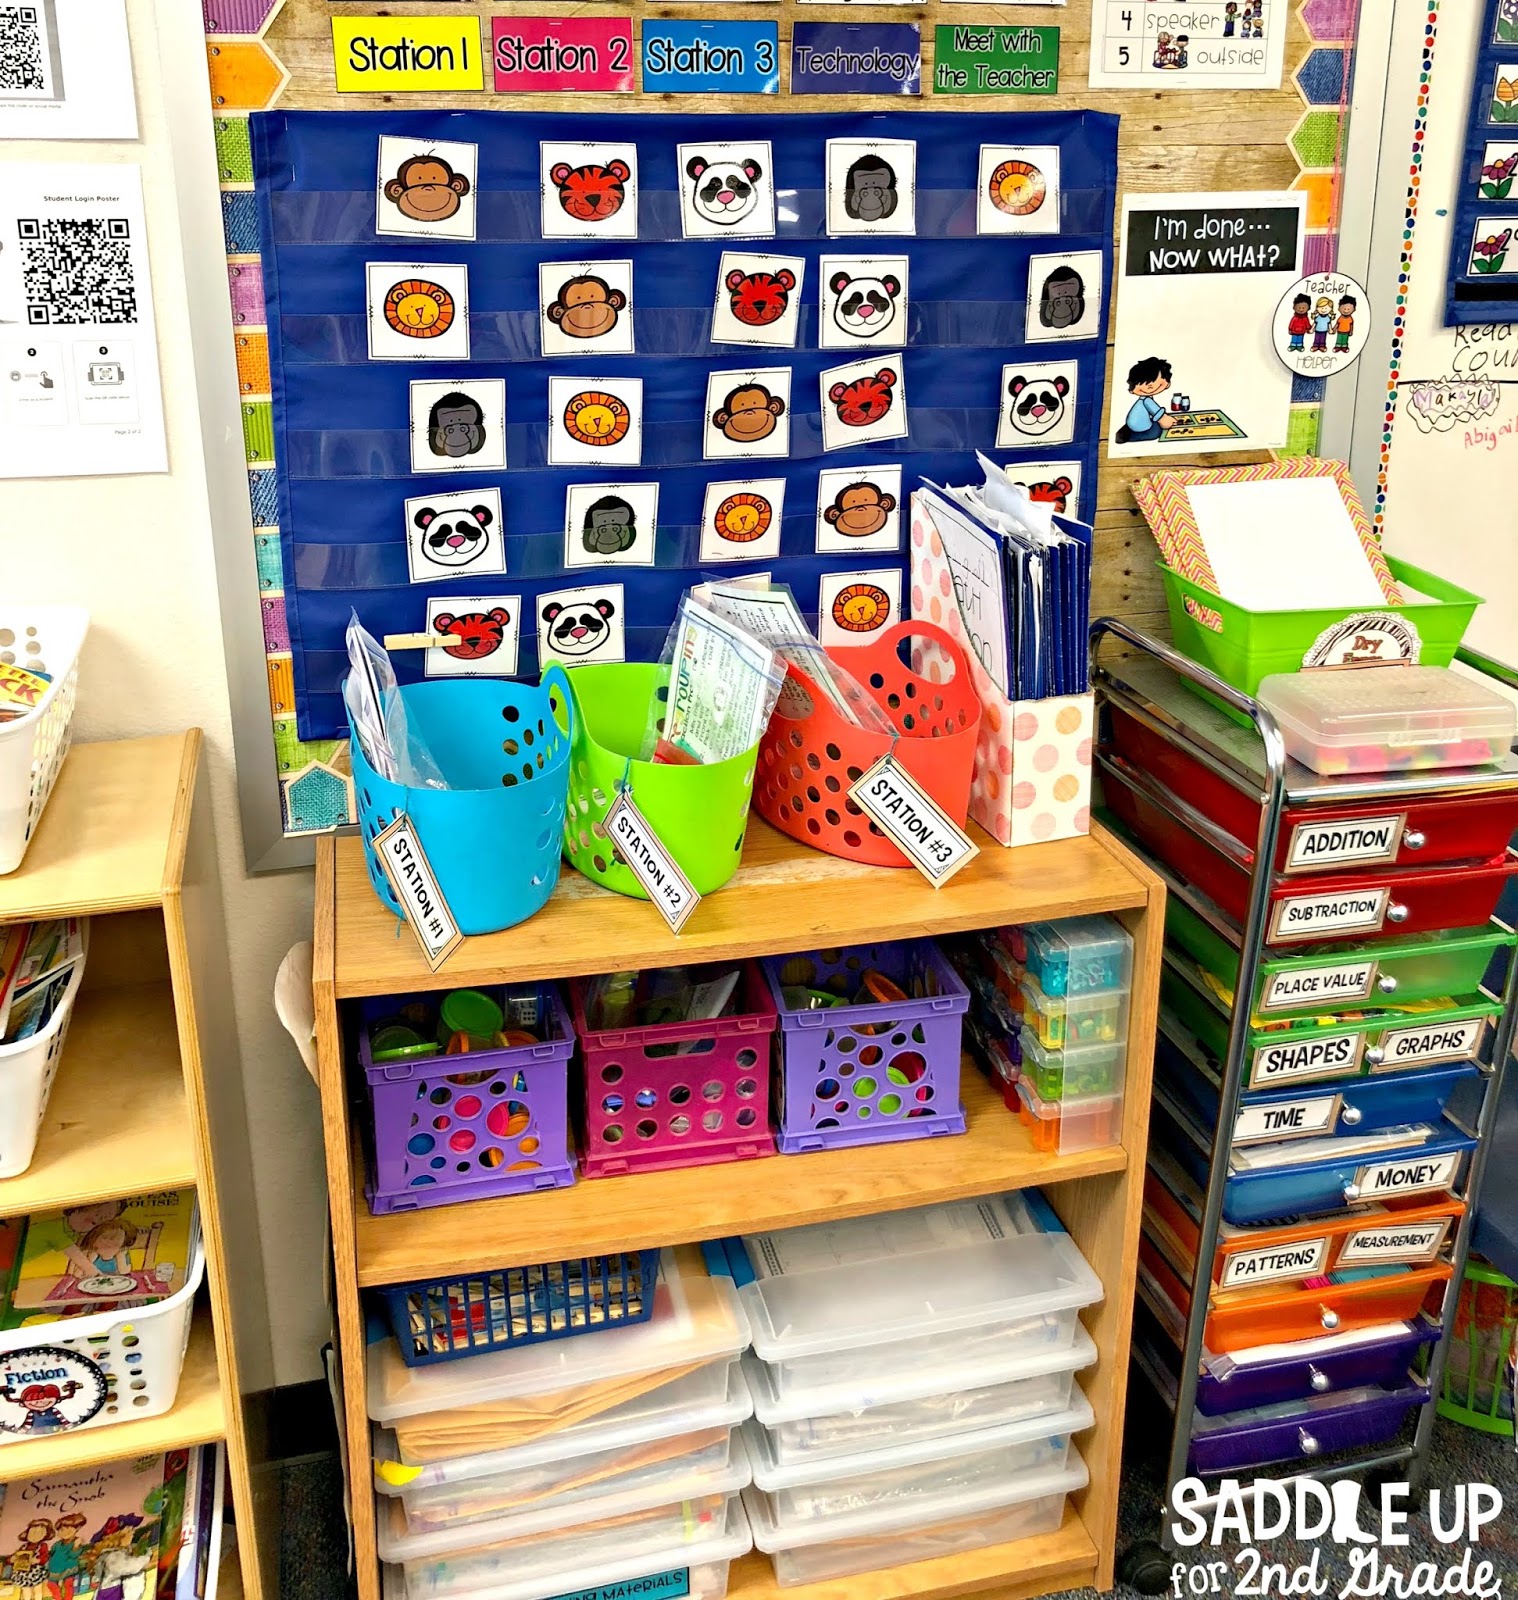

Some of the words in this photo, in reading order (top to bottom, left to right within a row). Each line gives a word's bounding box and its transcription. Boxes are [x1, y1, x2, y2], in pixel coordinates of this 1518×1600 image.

[1121, 10, 1132, 31] 4
[1146, 12, 1220, 33] speaker
[954, 27, 995, 52] Meet
[1003, 29, 1041, 52] with
[350, 37, 454, 71] Station
[461, 37, 469, 70] 1
[496, 37, 597, 72] Station
[609, 37, 630, 71] 2
[646, 38, 742, 73] Station
[755, 41, 774, 74] 3
[797, 47, 920, 79] Technology
[1118, 46, 1130, 66] 5
[1197, 49, 1264, 66] outside
[938, 67, 967, 88] the
[975, 64, 1055, 88] Teacher
[74, 195, 95, 203] Login
[1154, 215, 1187, 241] I'm
[1150, 248, 1201, 272] NOW
[1305, 280, 1350, 295] Teacher
[1352, 635, 1384, 654] Dry
[871, 779, 934, 844] STATION
[927, 839, 953, 862] #3
[1302, 826, 1389, 855] ADDITION
[617, 816, 665, 887] STATION
[663, 884, 681, 908] #2
[393, 838, 434, 919] STATION
[428, 917, 444, 939] #1
[1288, 899, 1376, 922] SUBTRACTION
[1275, 980, 1318, 995] PLACE
[1323, 971, 1366, 990] VALUE
[1396, 1029, 1465, 1056] GRAPHS
[1266, 1038, 1350, 1073] SHAPES
[1263, 1107, 1306, 1130] TIME
[1375, 1163, 1442, 1188] MONEY
[1352, 1232, 1435, 1248] MEASUREMENT
[1235, 1248, 1315, 1276] PATTERNS
[5, 1367, 69, 1385] Fiction
[21, 1470, 114, 1501] Samantha
[36, 1494, 57, 1509] the
[60, 1487, 106, 1513] Snob
